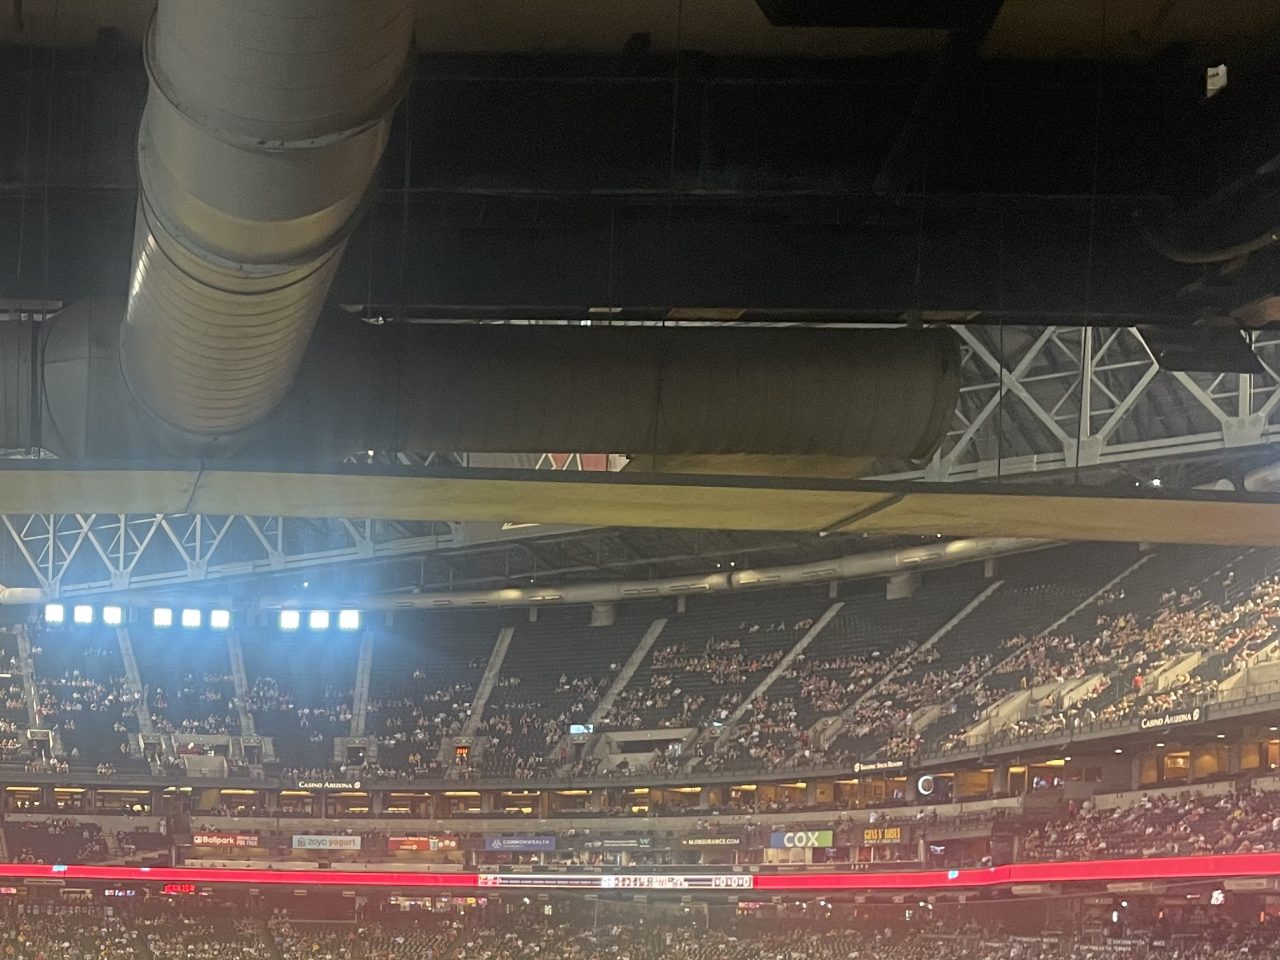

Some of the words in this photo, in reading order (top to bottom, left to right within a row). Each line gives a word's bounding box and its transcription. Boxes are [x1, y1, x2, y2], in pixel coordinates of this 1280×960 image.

[1141, 718, 1163, 728] CASINO
[1164, 713, 1192, 725] ARIZONA
[323, 781, 353, 789] ARIZONA
[203, 835, 235, 846] Ballpark
[308, 837, 328, 847] zoyo
[328, 836, 356, 847] yogurt
[784, 831, 820, 847] COX
